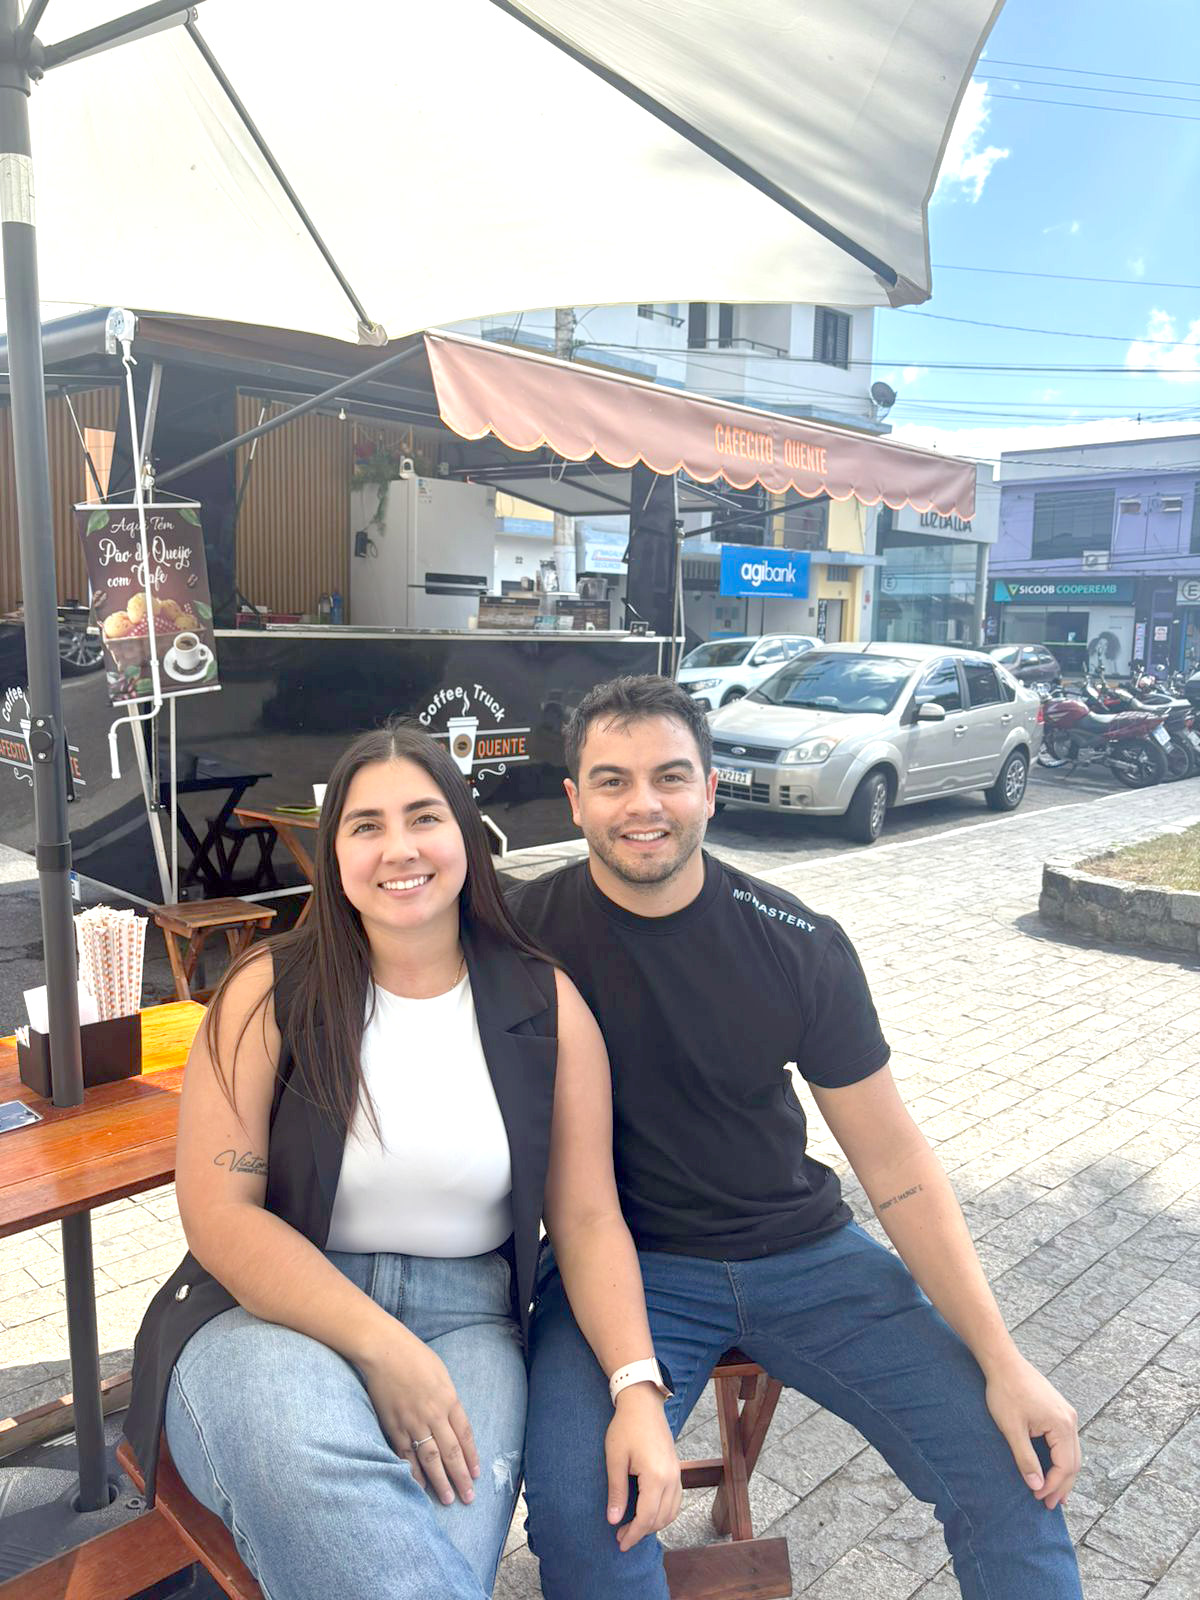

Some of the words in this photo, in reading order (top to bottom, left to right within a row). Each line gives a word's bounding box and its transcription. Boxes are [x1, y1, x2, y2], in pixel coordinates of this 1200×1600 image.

[714, 423, 774, 465] CAFECITO
[783, 438, 828, 475] QUENTE
[134, 542, 151, 562] d
[152, 535, 192, 570] Queijo
[106, 576, 131, 588] com
[740, 560, 798, 588] agibank
[1018, 584, 1056, 595] SICOOB
[1056, 583, 1118, 595] COOPEREMB
[2, 685, 24, 723] Coffee
[418, 685, 464, 727] Coffee
[473, 683, 506, 724] Truck
[0, 738, 28, 762] AFECITO
[476, 736, 527, 759] QUENTE
[732, 888, 817, 933] MONASTERY
